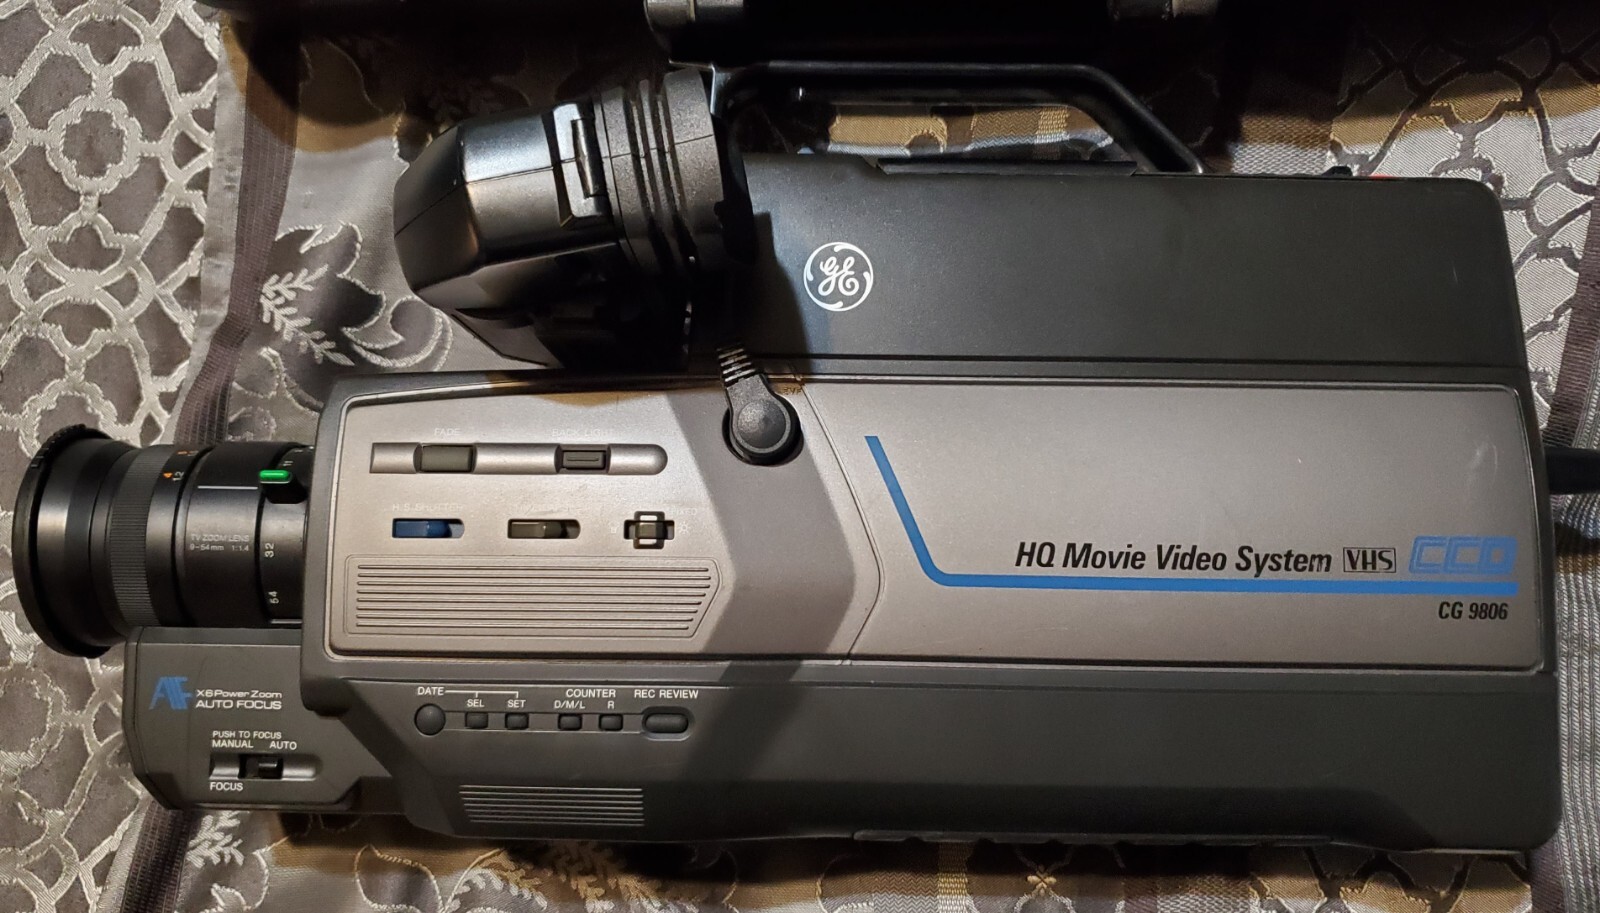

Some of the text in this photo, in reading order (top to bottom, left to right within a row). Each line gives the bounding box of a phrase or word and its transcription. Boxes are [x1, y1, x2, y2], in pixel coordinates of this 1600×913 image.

[818, 256, 859, 296] GE
[434, 428, 461, 436] FADE
[552, 428, 580, 438] BACK
[202, 534, 227, 542] ZOOM
[229, 534, 250, 542] LENS
[264, 542, 275, 558] 32
[1015, 541, 1333, 577] HQ Movie Video System
[1346, 549, 1393, 572] VHS
[1438, 601, 1509, 620] CG 9806
[250, 689, 282, 699] Zoom
[417, 686, 445, 696] DATE
[565, 688, 616, 699] COUNTER
[633, 688, 699, 700] REC REVIEW
[195, 699, 282, 711] AUTO FOCUS
[466, 699, 485, 709] SEL
[507, 700, 526, 709] SET
[553, 700, 586, 710] D/M/L
[607, 701, 615, 710] R
[212, 730, 282, 740] PUSH TO FOCUS
[211, 740, 254, 749] MANUAL
[269, 740, 298, 750] AUTO
[209, 782, 244, 792] FOCUS
